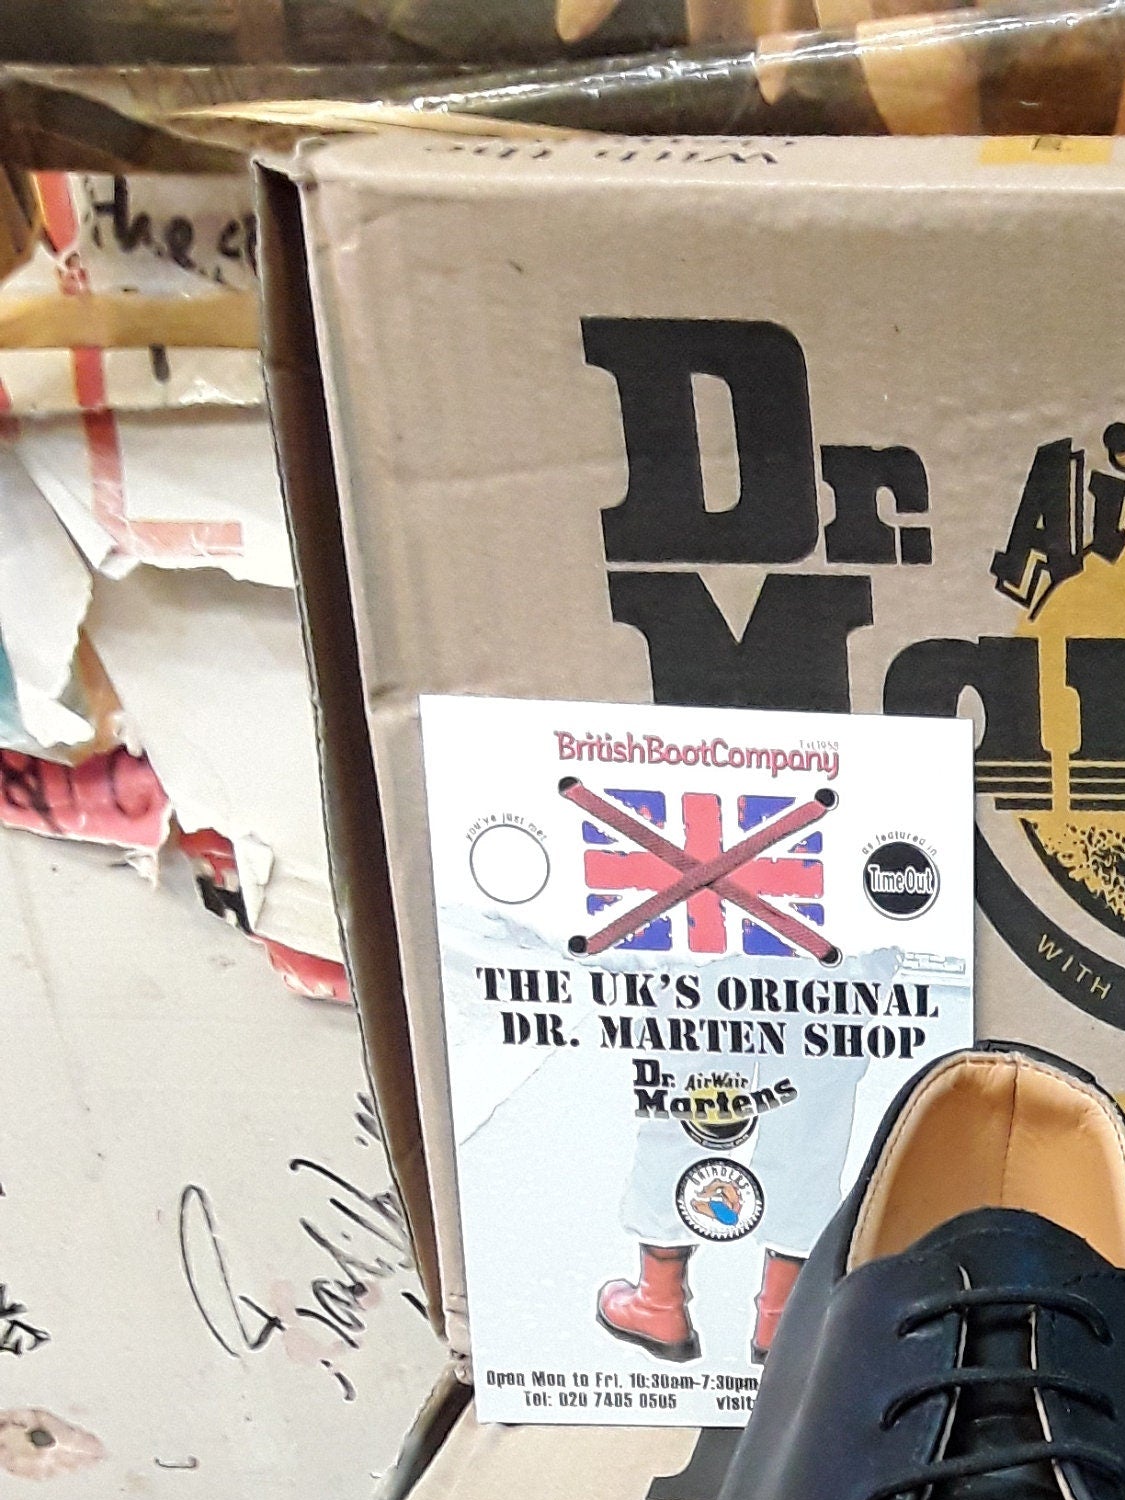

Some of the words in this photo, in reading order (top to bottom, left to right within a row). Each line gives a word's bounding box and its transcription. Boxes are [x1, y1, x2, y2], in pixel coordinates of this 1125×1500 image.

[554, 730, 840, 780] BritishBootCompany
[1037, 933, 1113, 1000] WITH
[475, 967, 573, 1004] THE
[588, 971, 700, 1009] UK'S
[717, 977, 939, 1018] ORIGINAL
[500, 1011, 581, 1048] DR.
[599, 1015, 787, 1055] MARTEN
[804, 1023, 927, 1060] SHOP
[634, 1077, 799, 1120] Martens
[685, 1071, 750, 1092] AirWair
[486, 1370, 526, 1389] Open
[532, 1371, 566, 1388] Mon
[573, 1372, 590, 1388] to
[559, 1391, 588, 1407] 020
[594, 1392, 633, 1408] 7405
[639, 1393, 677, 1409] 0505
